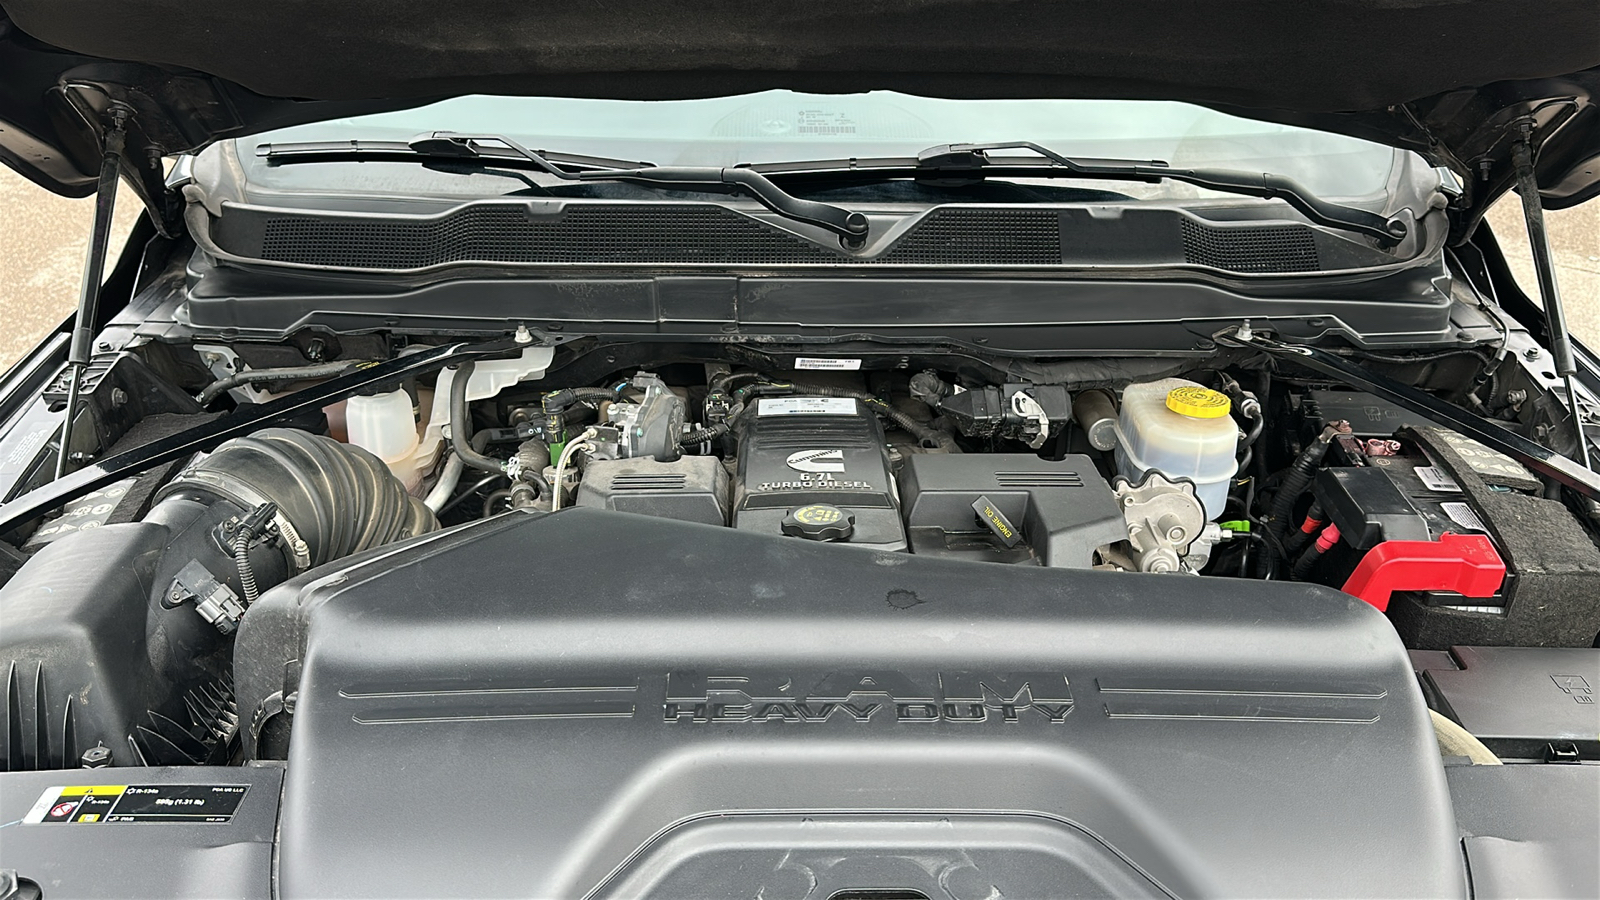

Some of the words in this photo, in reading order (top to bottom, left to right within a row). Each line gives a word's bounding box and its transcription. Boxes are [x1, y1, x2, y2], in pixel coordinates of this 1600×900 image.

[788, 449, 838, 464] Cummins
[800, 472, 835, 482] 6.7L
[761, 481, 813, 490] TURBO
[818, 481, 872, 490] DIESEL
[983, 506, 994, 518] OIL
[991, 515, 1013, 538] ENGINE
[664, 671, 1074, 703] RAM
[663, 702, 883, 724] HEAVY
[896, 702, 1075, 723] DUTY
